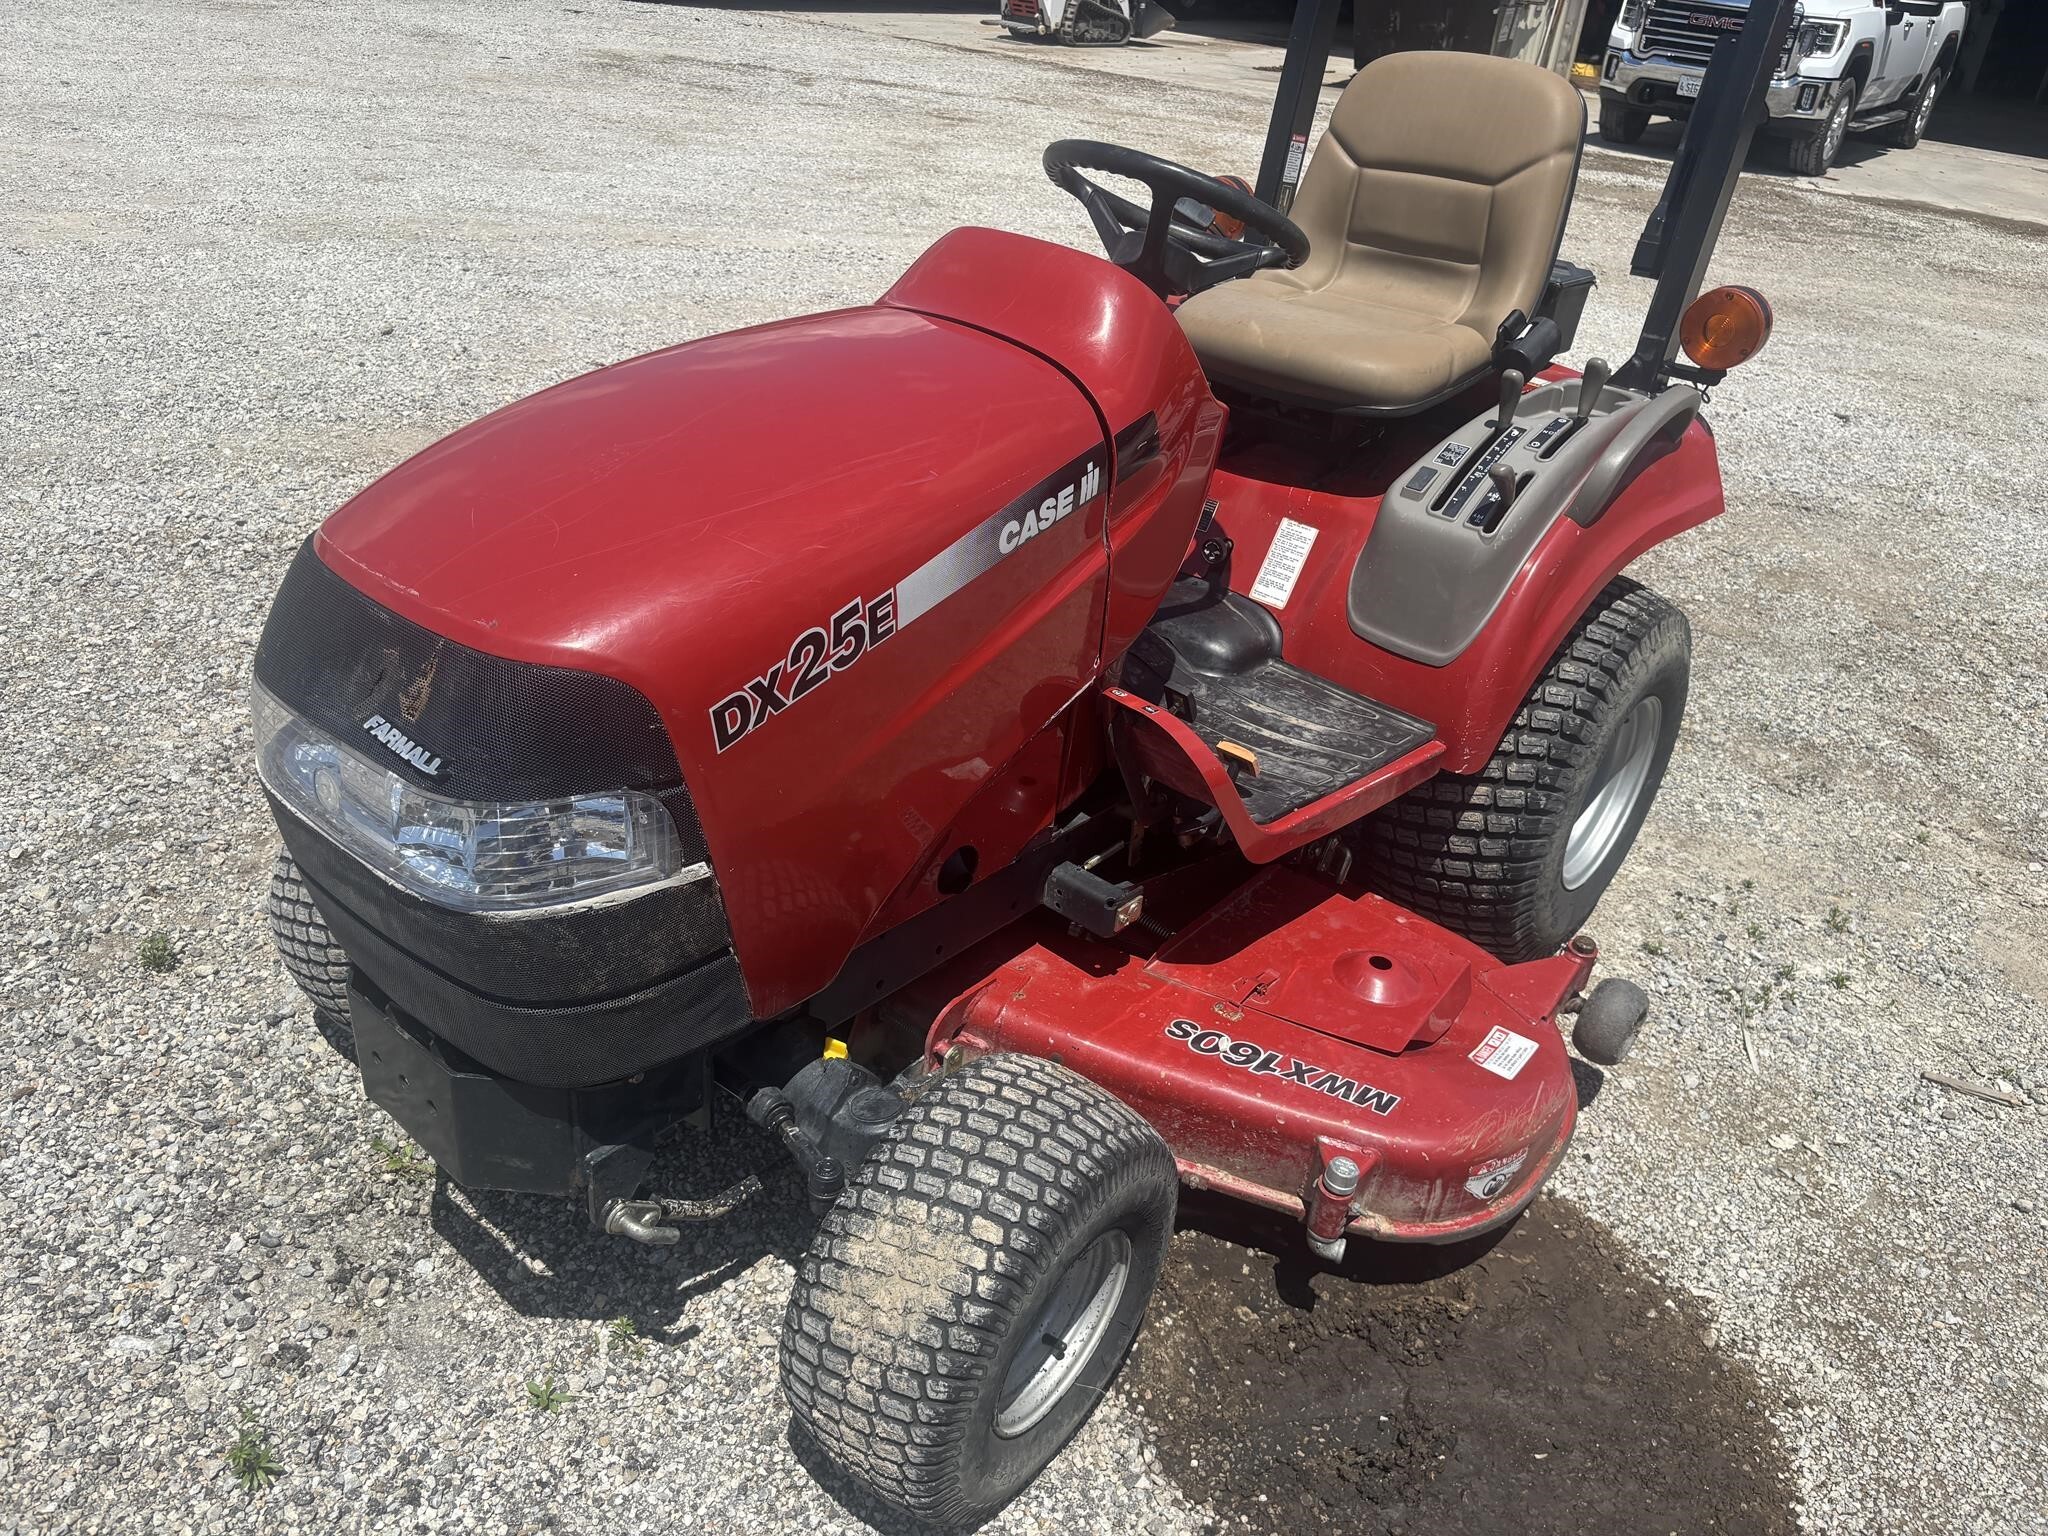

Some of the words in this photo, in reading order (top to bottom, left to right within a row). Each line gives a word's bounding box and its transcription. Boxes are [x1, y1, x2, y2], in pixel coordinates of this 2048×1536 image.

[1690, 12, 1745, 31] GMC
[999, 483, 1074, 554] CASE
[709, 587, 896, 754] DX25E
[363, 714, 441, 775] FARMALL
[1164, 1018, 1401, 1116] MWX160S
